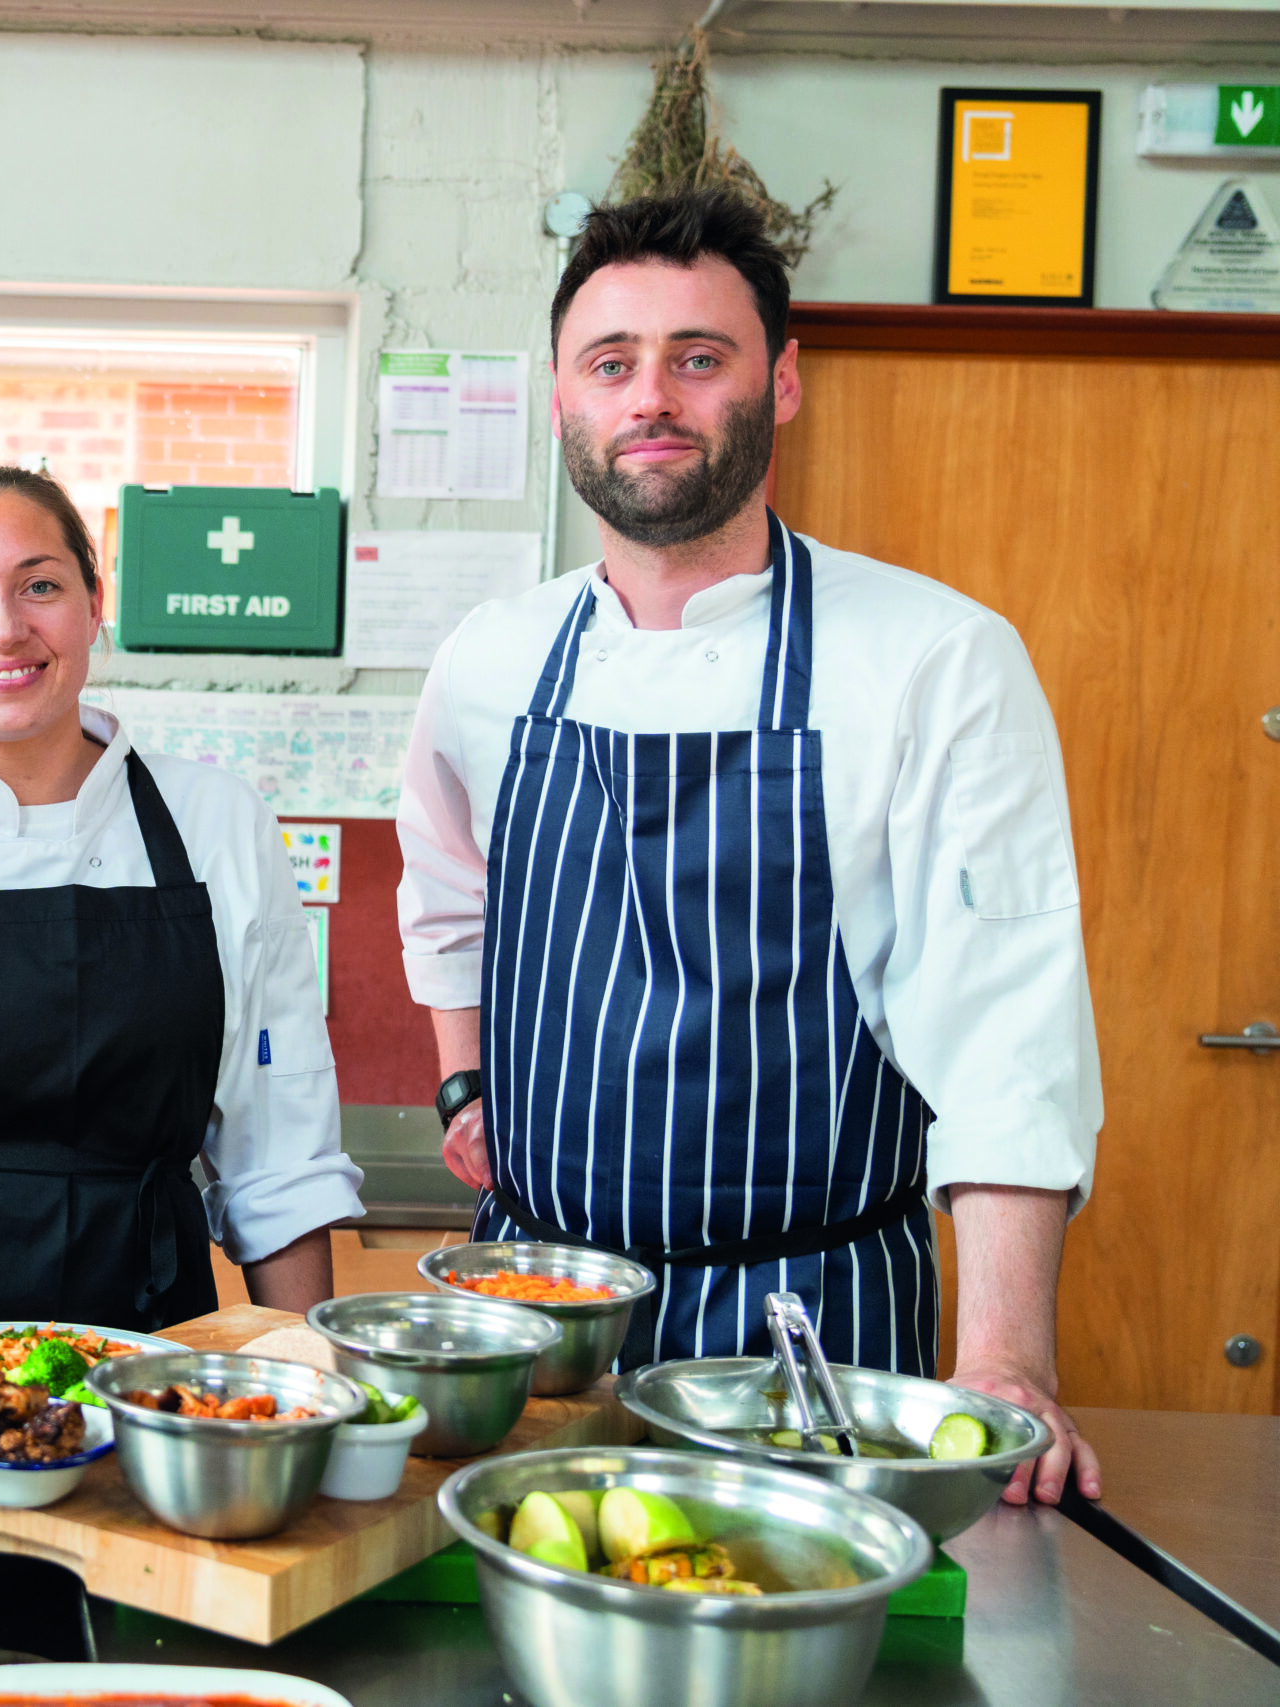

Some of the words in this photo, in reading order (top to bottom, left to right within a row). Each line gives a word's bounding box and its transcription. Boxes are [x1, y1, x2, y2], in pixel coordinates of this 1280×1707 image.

[166, 593, 241, 616] FIRST
[244, 595, 291, 618] AID
[289, 855, 310, 869] SH
